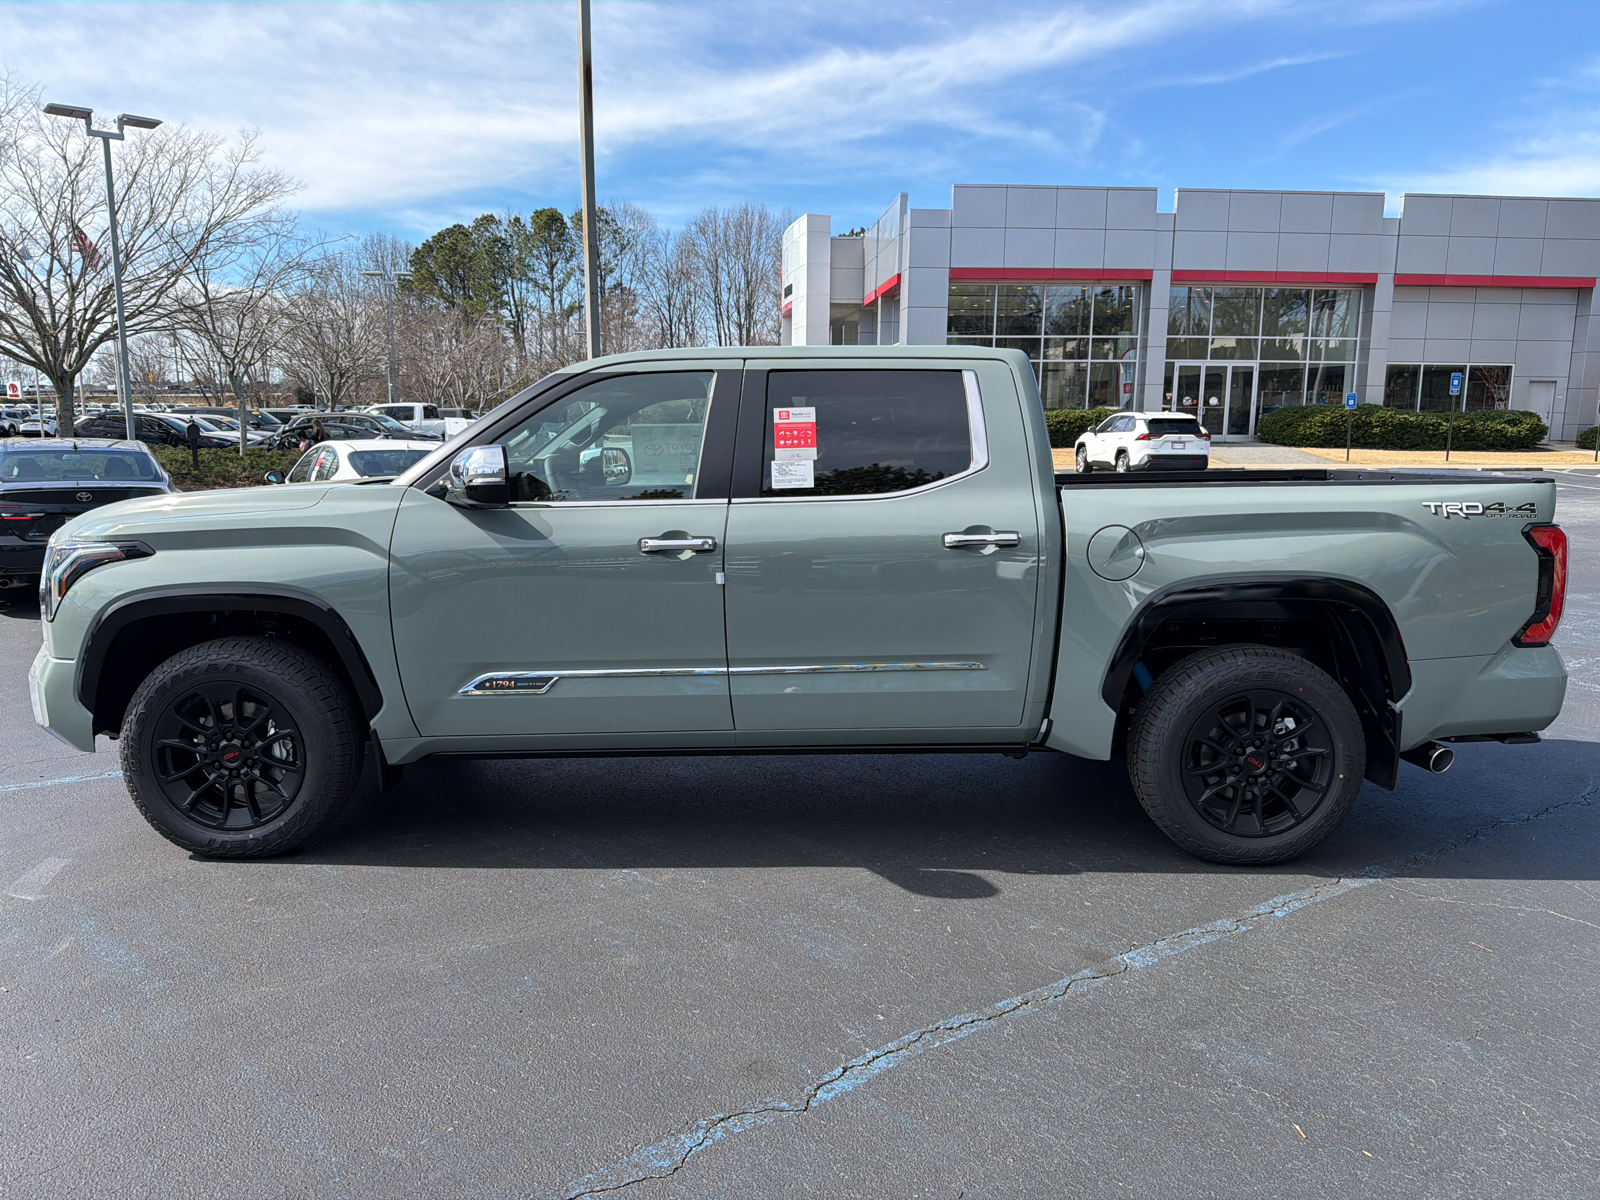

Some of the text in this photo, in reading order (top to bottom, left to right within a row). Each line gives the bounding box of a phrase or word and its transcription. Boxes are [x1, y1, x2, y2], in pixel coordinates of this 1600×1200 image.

[665, 442, 700, 451] TOYOT
[1422, 502, 1483, 517] TRD
[492, 680, 515, 688] 1794
